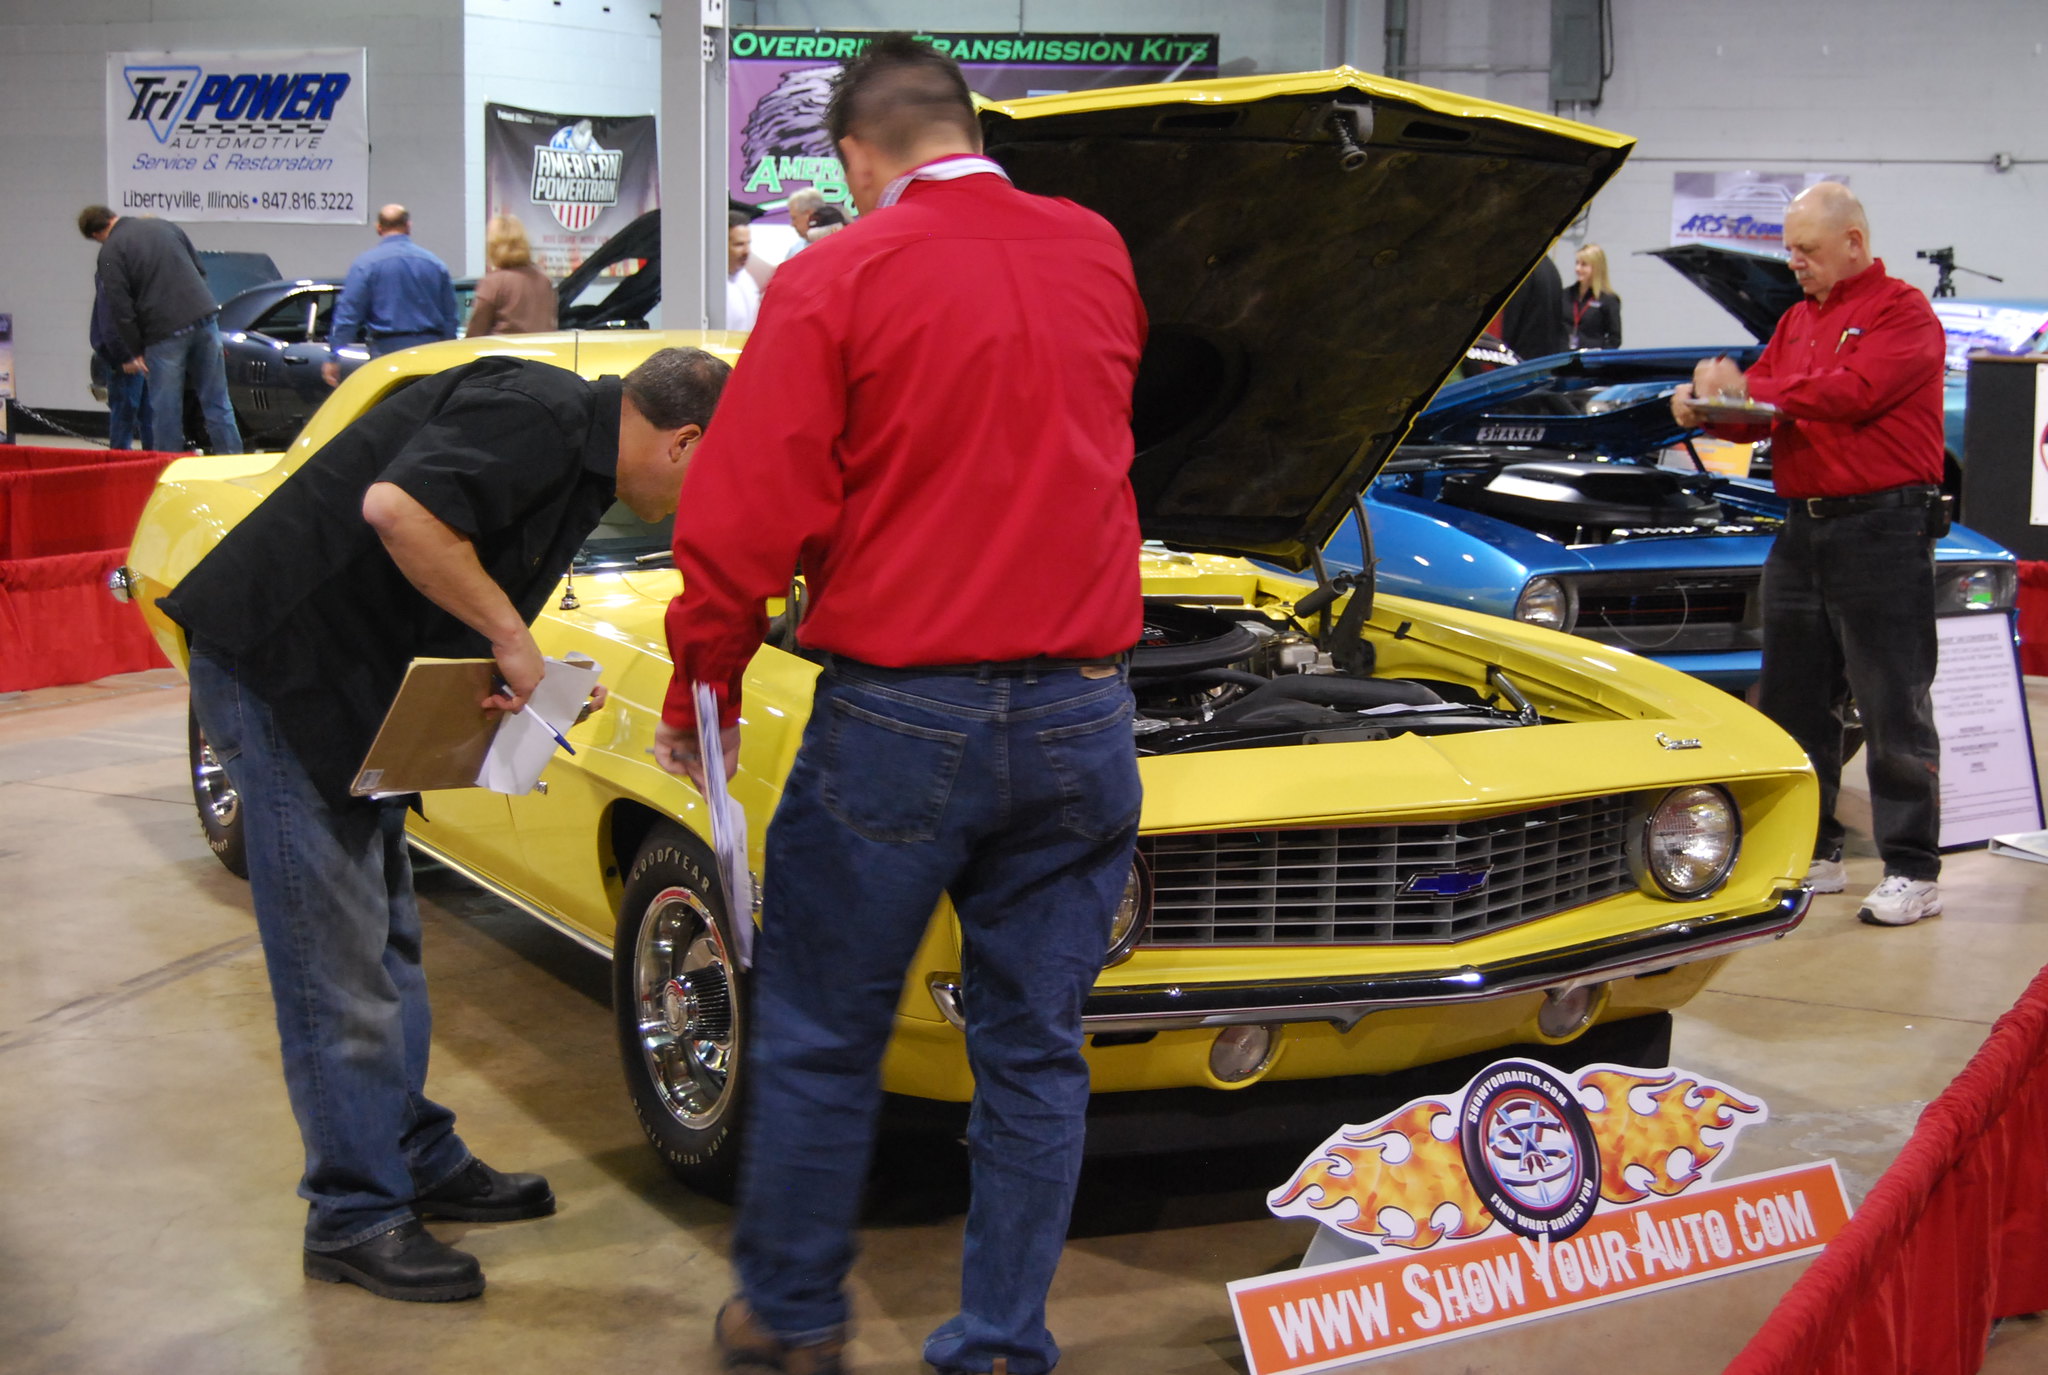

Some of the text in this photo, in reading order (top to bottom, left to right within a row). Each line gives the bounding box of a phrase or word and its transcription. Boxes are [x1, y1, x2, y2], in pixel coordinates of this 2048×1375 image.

[732, 32, 1209, 62] OVERDRI RANSMISSION KITS
[127, 73, 351, 121] Tri POWER
[170, 137, 322, 149] AUTOMOTIVE
[132, 153, 333, 171] Service & Restoration
[538, 150, 620, 179] AMERICAN
[744, 156, 846, 193] AMER
[123, 191, 354, 211] Libertyville, Illinois 847.816.3222
[535, 176, 617, 202] POWERTRAIN
[1483, 428, 1540, 440] SHAKER
[633, 846, 710, 893] GOODYEAR
[1467, 1070, 1568, 1124] SHOWYOURAUTO.COM
[1490, 1177, 1594, 1232] FIND WHAT DRIVES YOU
